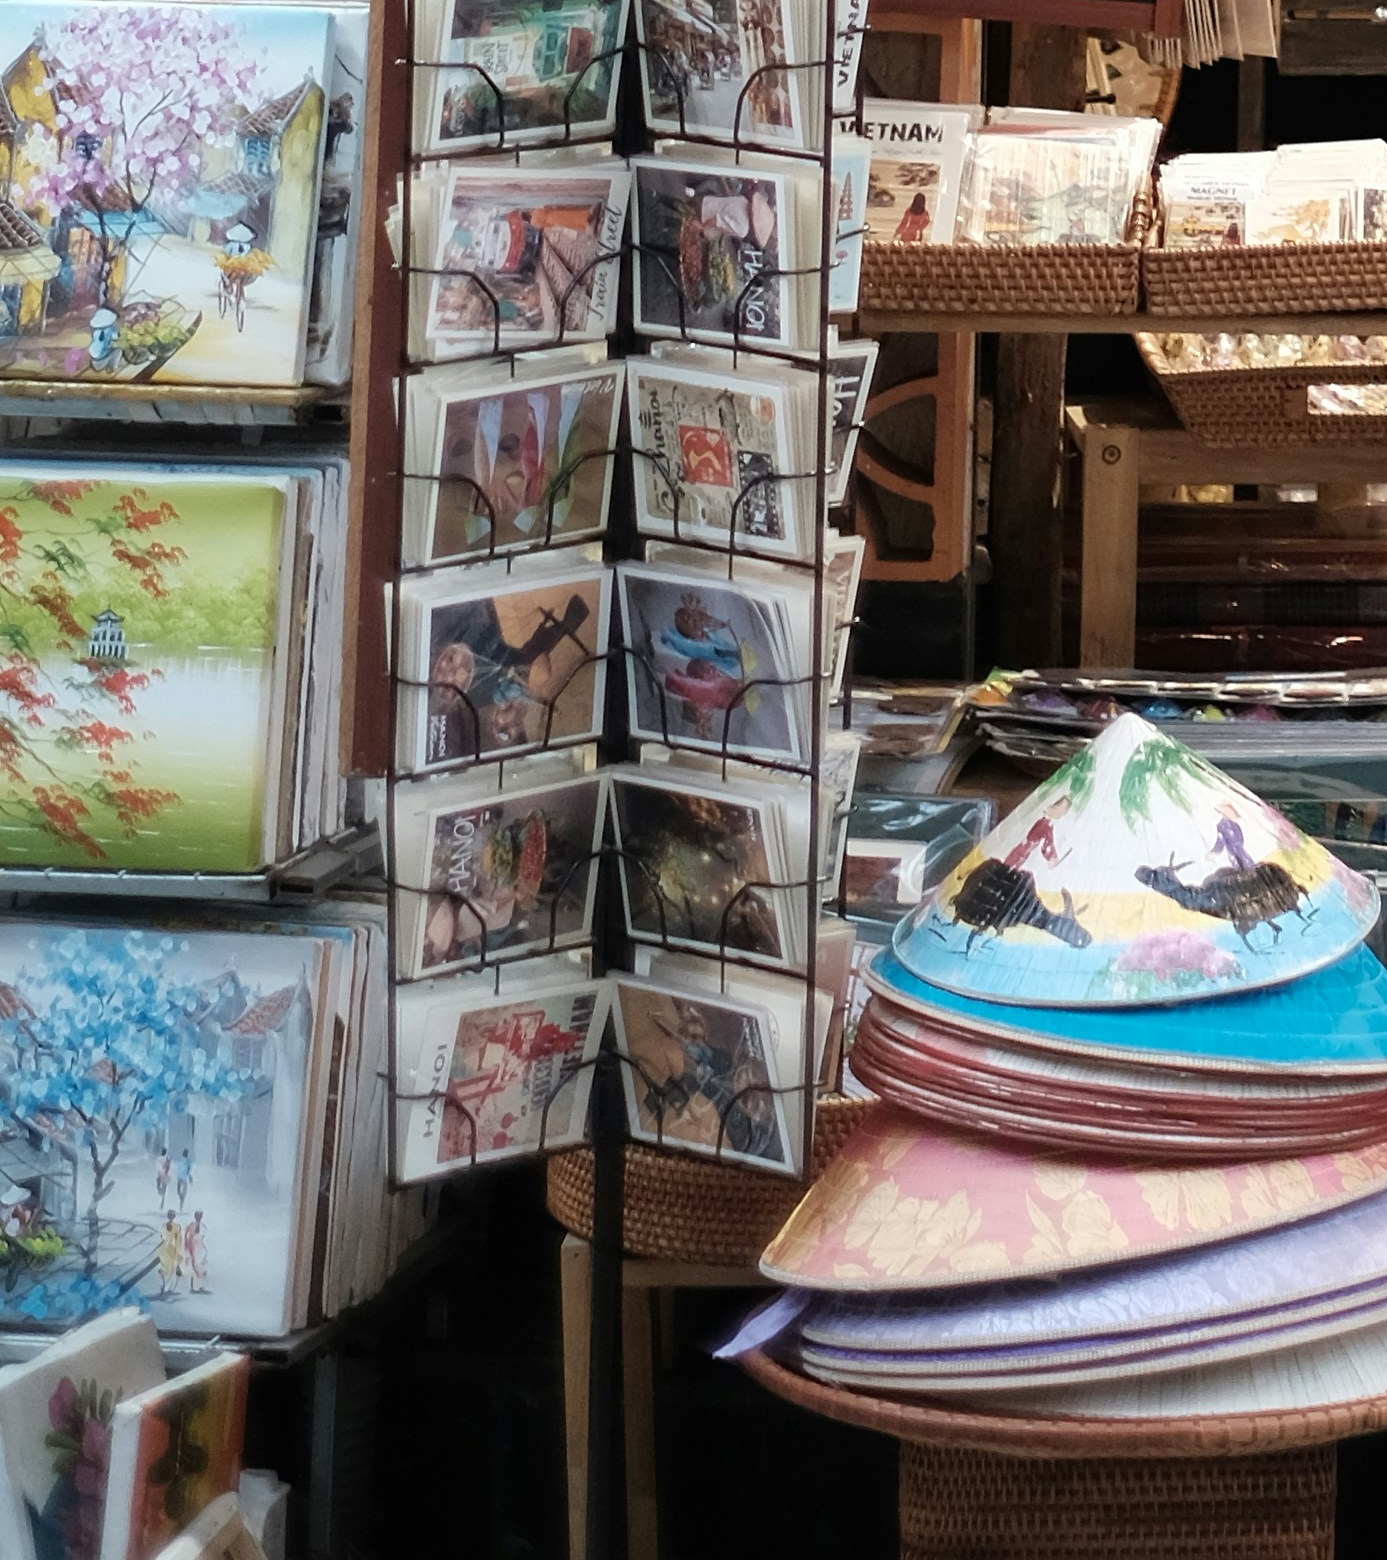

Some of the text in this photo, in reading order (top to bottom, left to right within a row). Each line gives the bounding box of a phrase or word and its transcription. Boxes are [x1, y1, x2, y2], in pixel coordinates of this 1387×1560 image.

[840, 121, 943, 143] VETNAM
[449, 814, 476, 892] HANOI
[423, 1043, 447, 1138] HANOI
